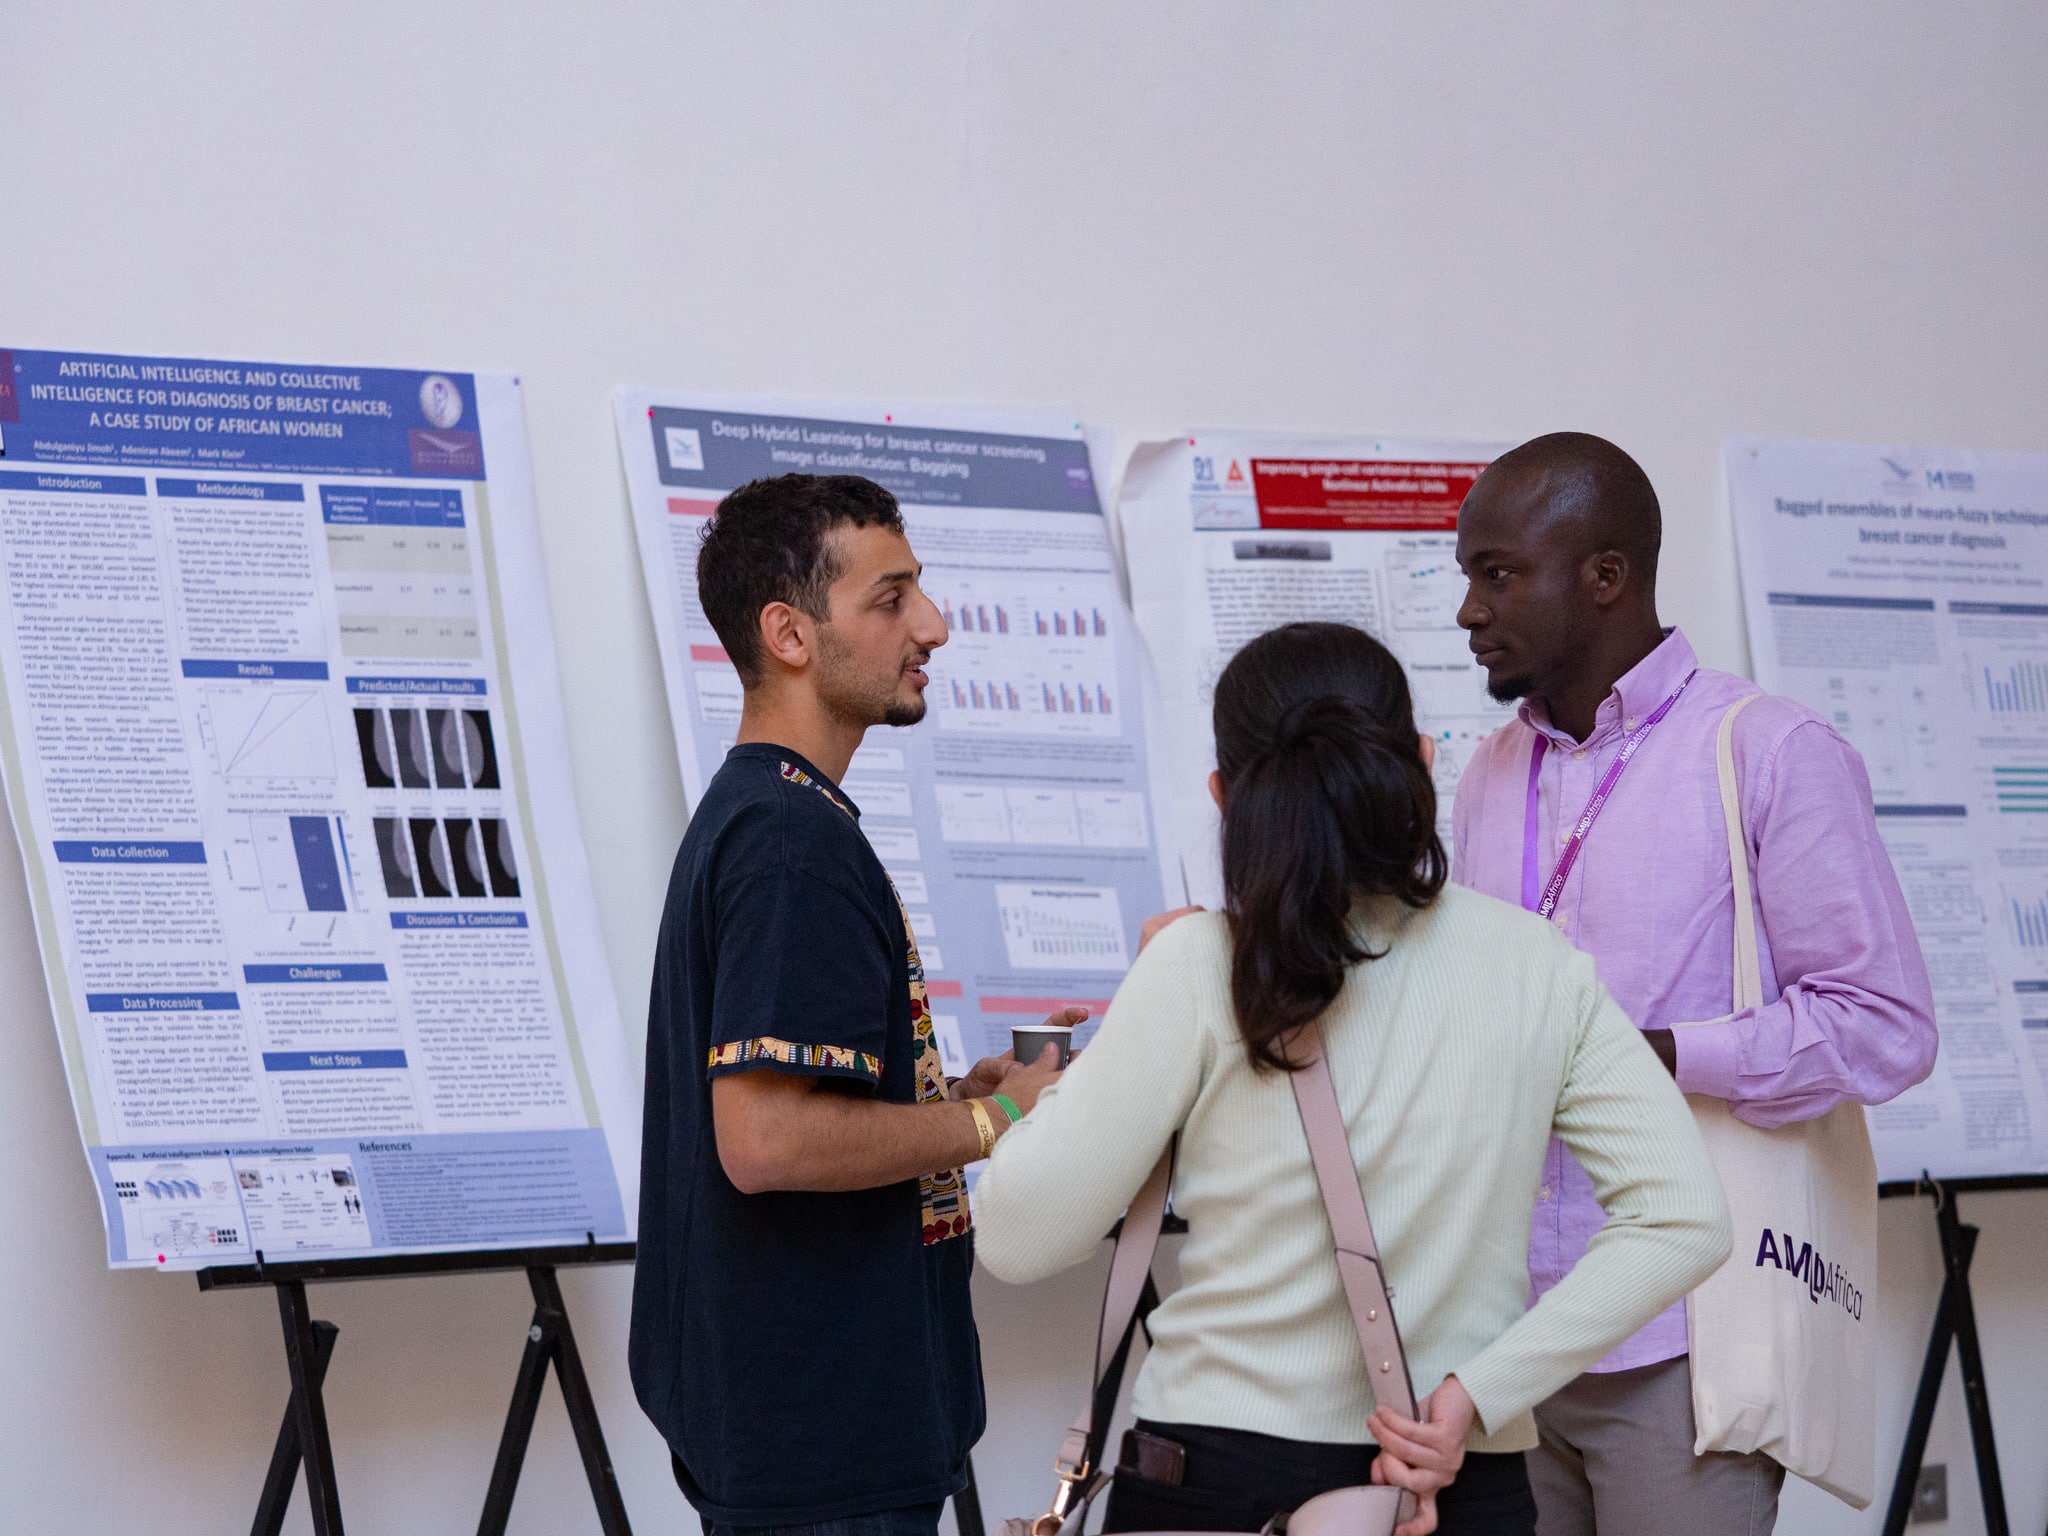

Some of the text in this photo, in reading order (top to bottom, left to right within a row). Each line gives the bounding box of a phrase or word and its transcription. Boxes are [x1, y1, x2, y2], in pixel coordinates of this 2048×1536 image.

[59, 361, 362, 391] ARTIFICIAL INTELLIGENCE AND COLLECTIVE
[31, 384, 136, 403] INTELLIGENCE
[138, 390, 167, 405] FOR
[170, 391, 250, 410] DIAGNOSIS
[253, 395, 273, 410] OF
[277, 396, 328, 413] BREAST
[90, 412, 343, 438] A CASE STUDY OF AFRICAN WOMEN
[711, 420, 1047, 464] Deep Hybrid Learning for breast cancer screening
[771, 446, 815, 467] image
[909, 456, 970, 479] Bagging
[38, 476, 102, 489] Introduction
[196, 483, 265, 498] Methodology
[237, 663, 274, 676] Results
[358, 680, 475, 693] Predicted/Actual Results
[91, 846, 169, 858] Data Collection
[406, 913, 518, 925] Discussion & Conclusion
[289, 967, 342, 981] Challenges
[122, 997, 204, 1010] Data Processing
[309, 1054, 363, 1067] Next Steps
[359, 1141, 412, 1152] References
